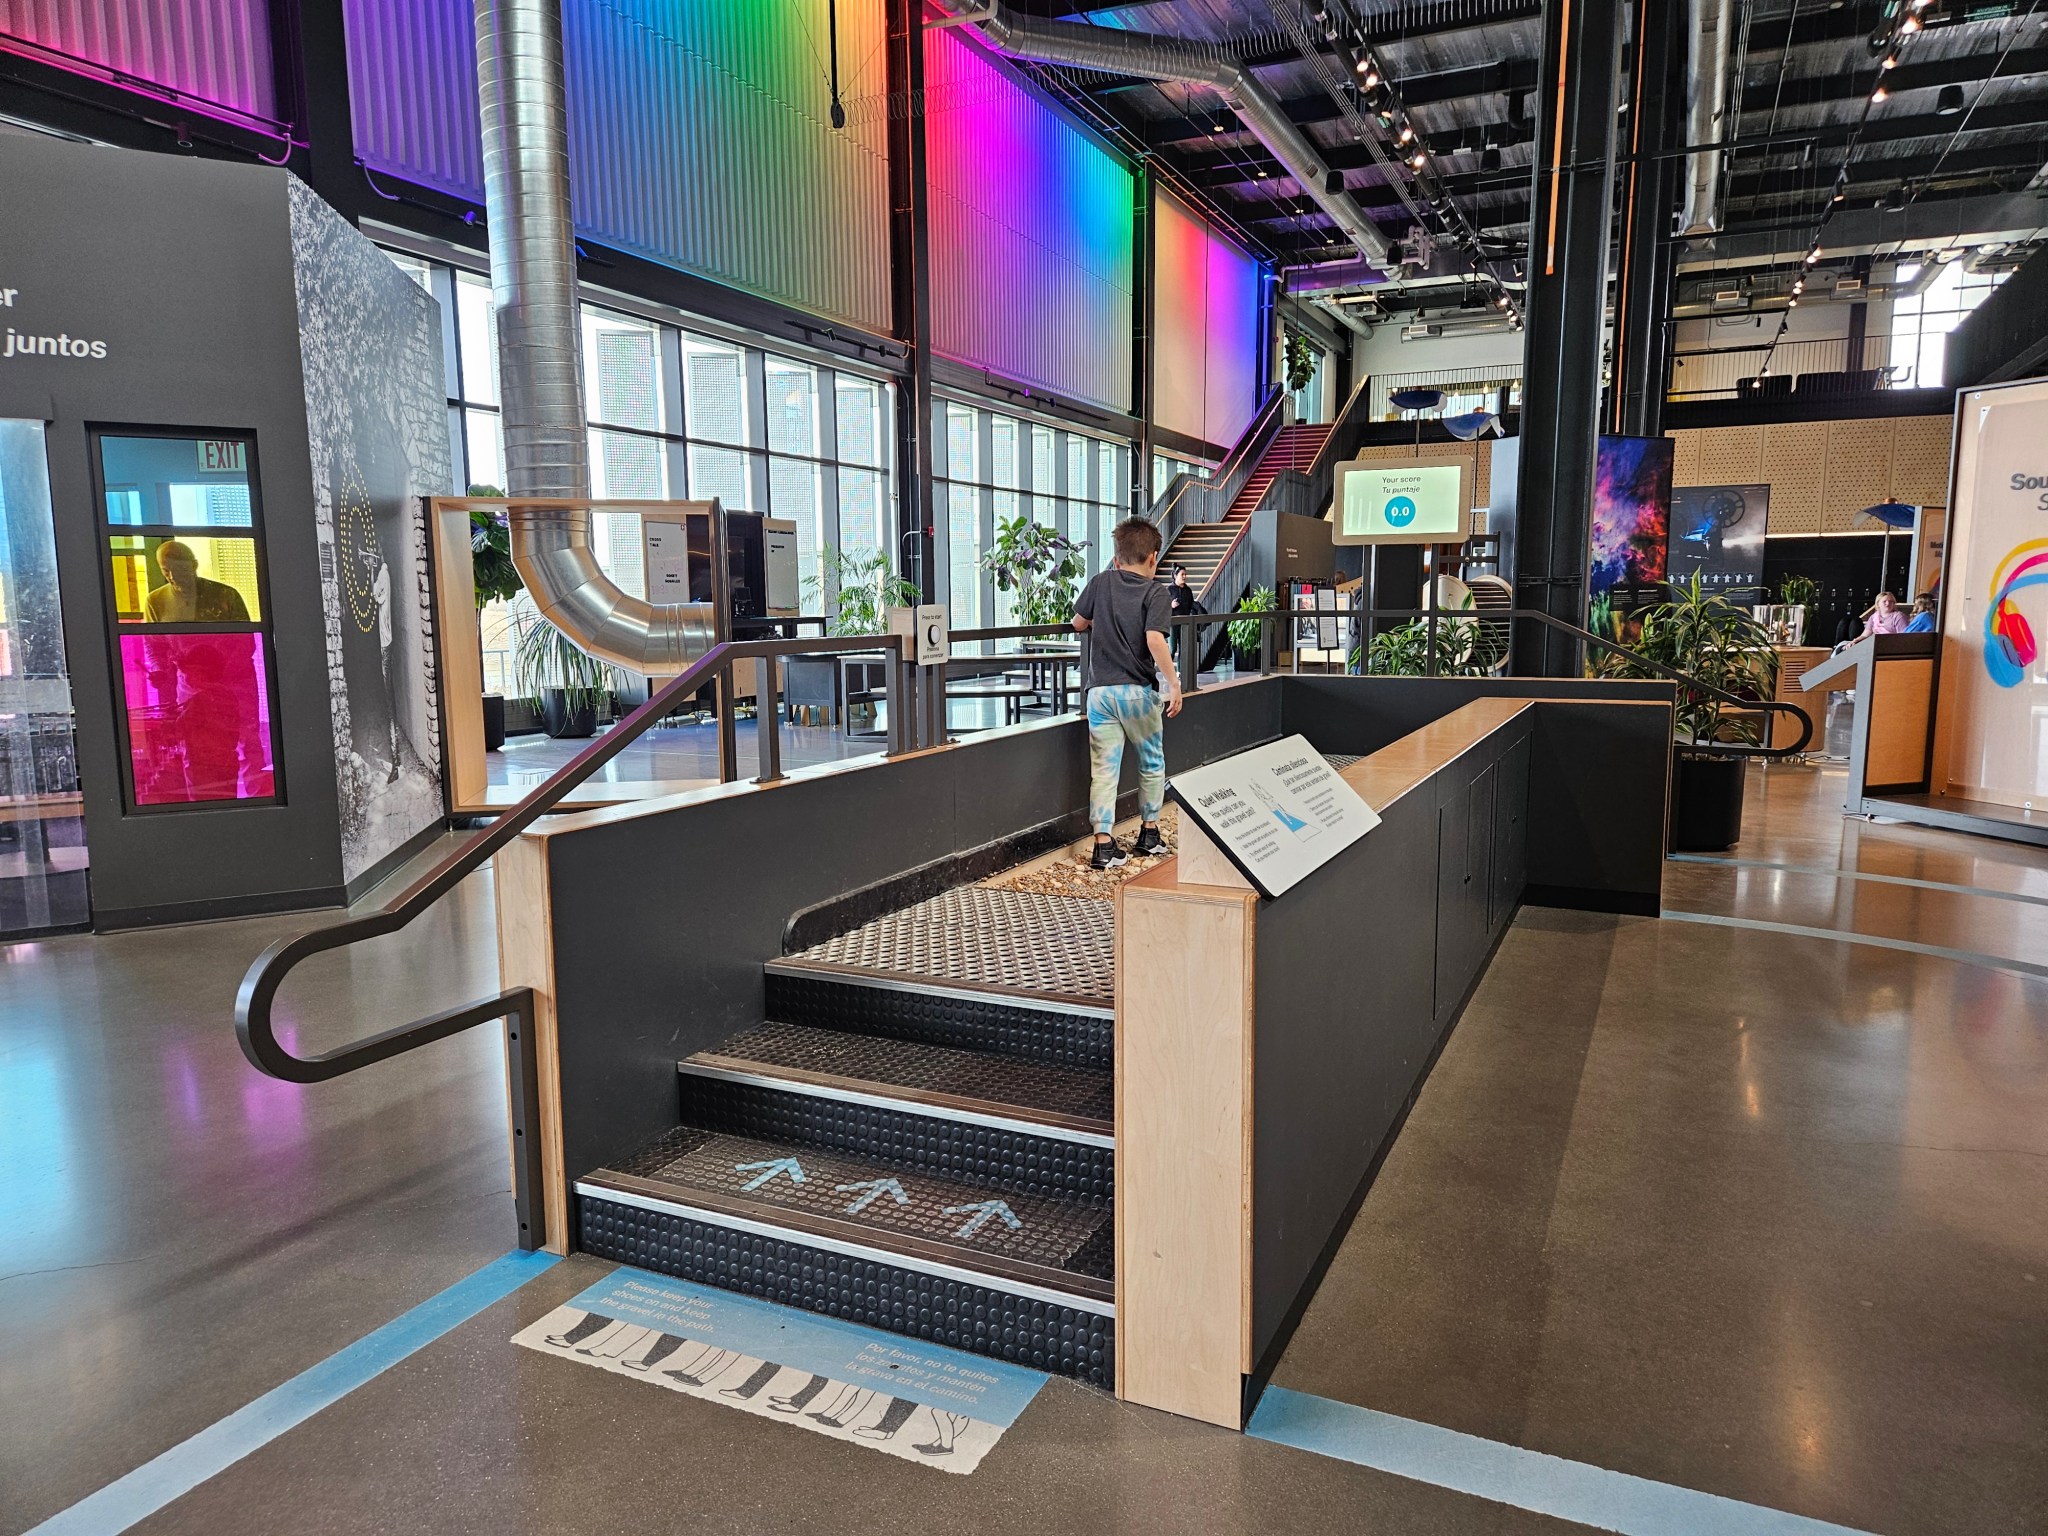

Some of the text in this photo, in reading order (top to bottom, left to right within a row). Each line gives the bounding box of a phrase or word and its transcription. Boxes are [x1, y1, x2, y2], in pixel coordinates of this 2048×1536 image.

[0, 288, 19, 307] r
[3, 327, 107, 359] juntos
[205, 441, 239, 469] EXIT
[1382, 476, 1398, 484] Your
[1392, 486, 1420, 494] puntaje
[1391, 506, 1410, 517] 0.0
[1197, 787, 1237, 808] Quiet Walking
[612, 1290, 644, 1302] shoes
[660, 1303, 684, 1311] and
[682, 1307, 711, 1320] keep
[624, 1281, 714, 1308] Please keep your
[600, 1297, 618, 1307] the
[618, 1302, 655, 1316] gravel
[666, 1315, 688, 1326] the
[855, 1352, 875, 1362] los
[873, 1360, 925, 1376] zaatos
[865, 1343, 999, 1384] Por favor, no te quites
[857, 1367, 895, 1380] grava
[895, 1376, 913, 1385] en
[914, 1380, 930, 1390] el
[929, 1386, 979, 1404] camino.
